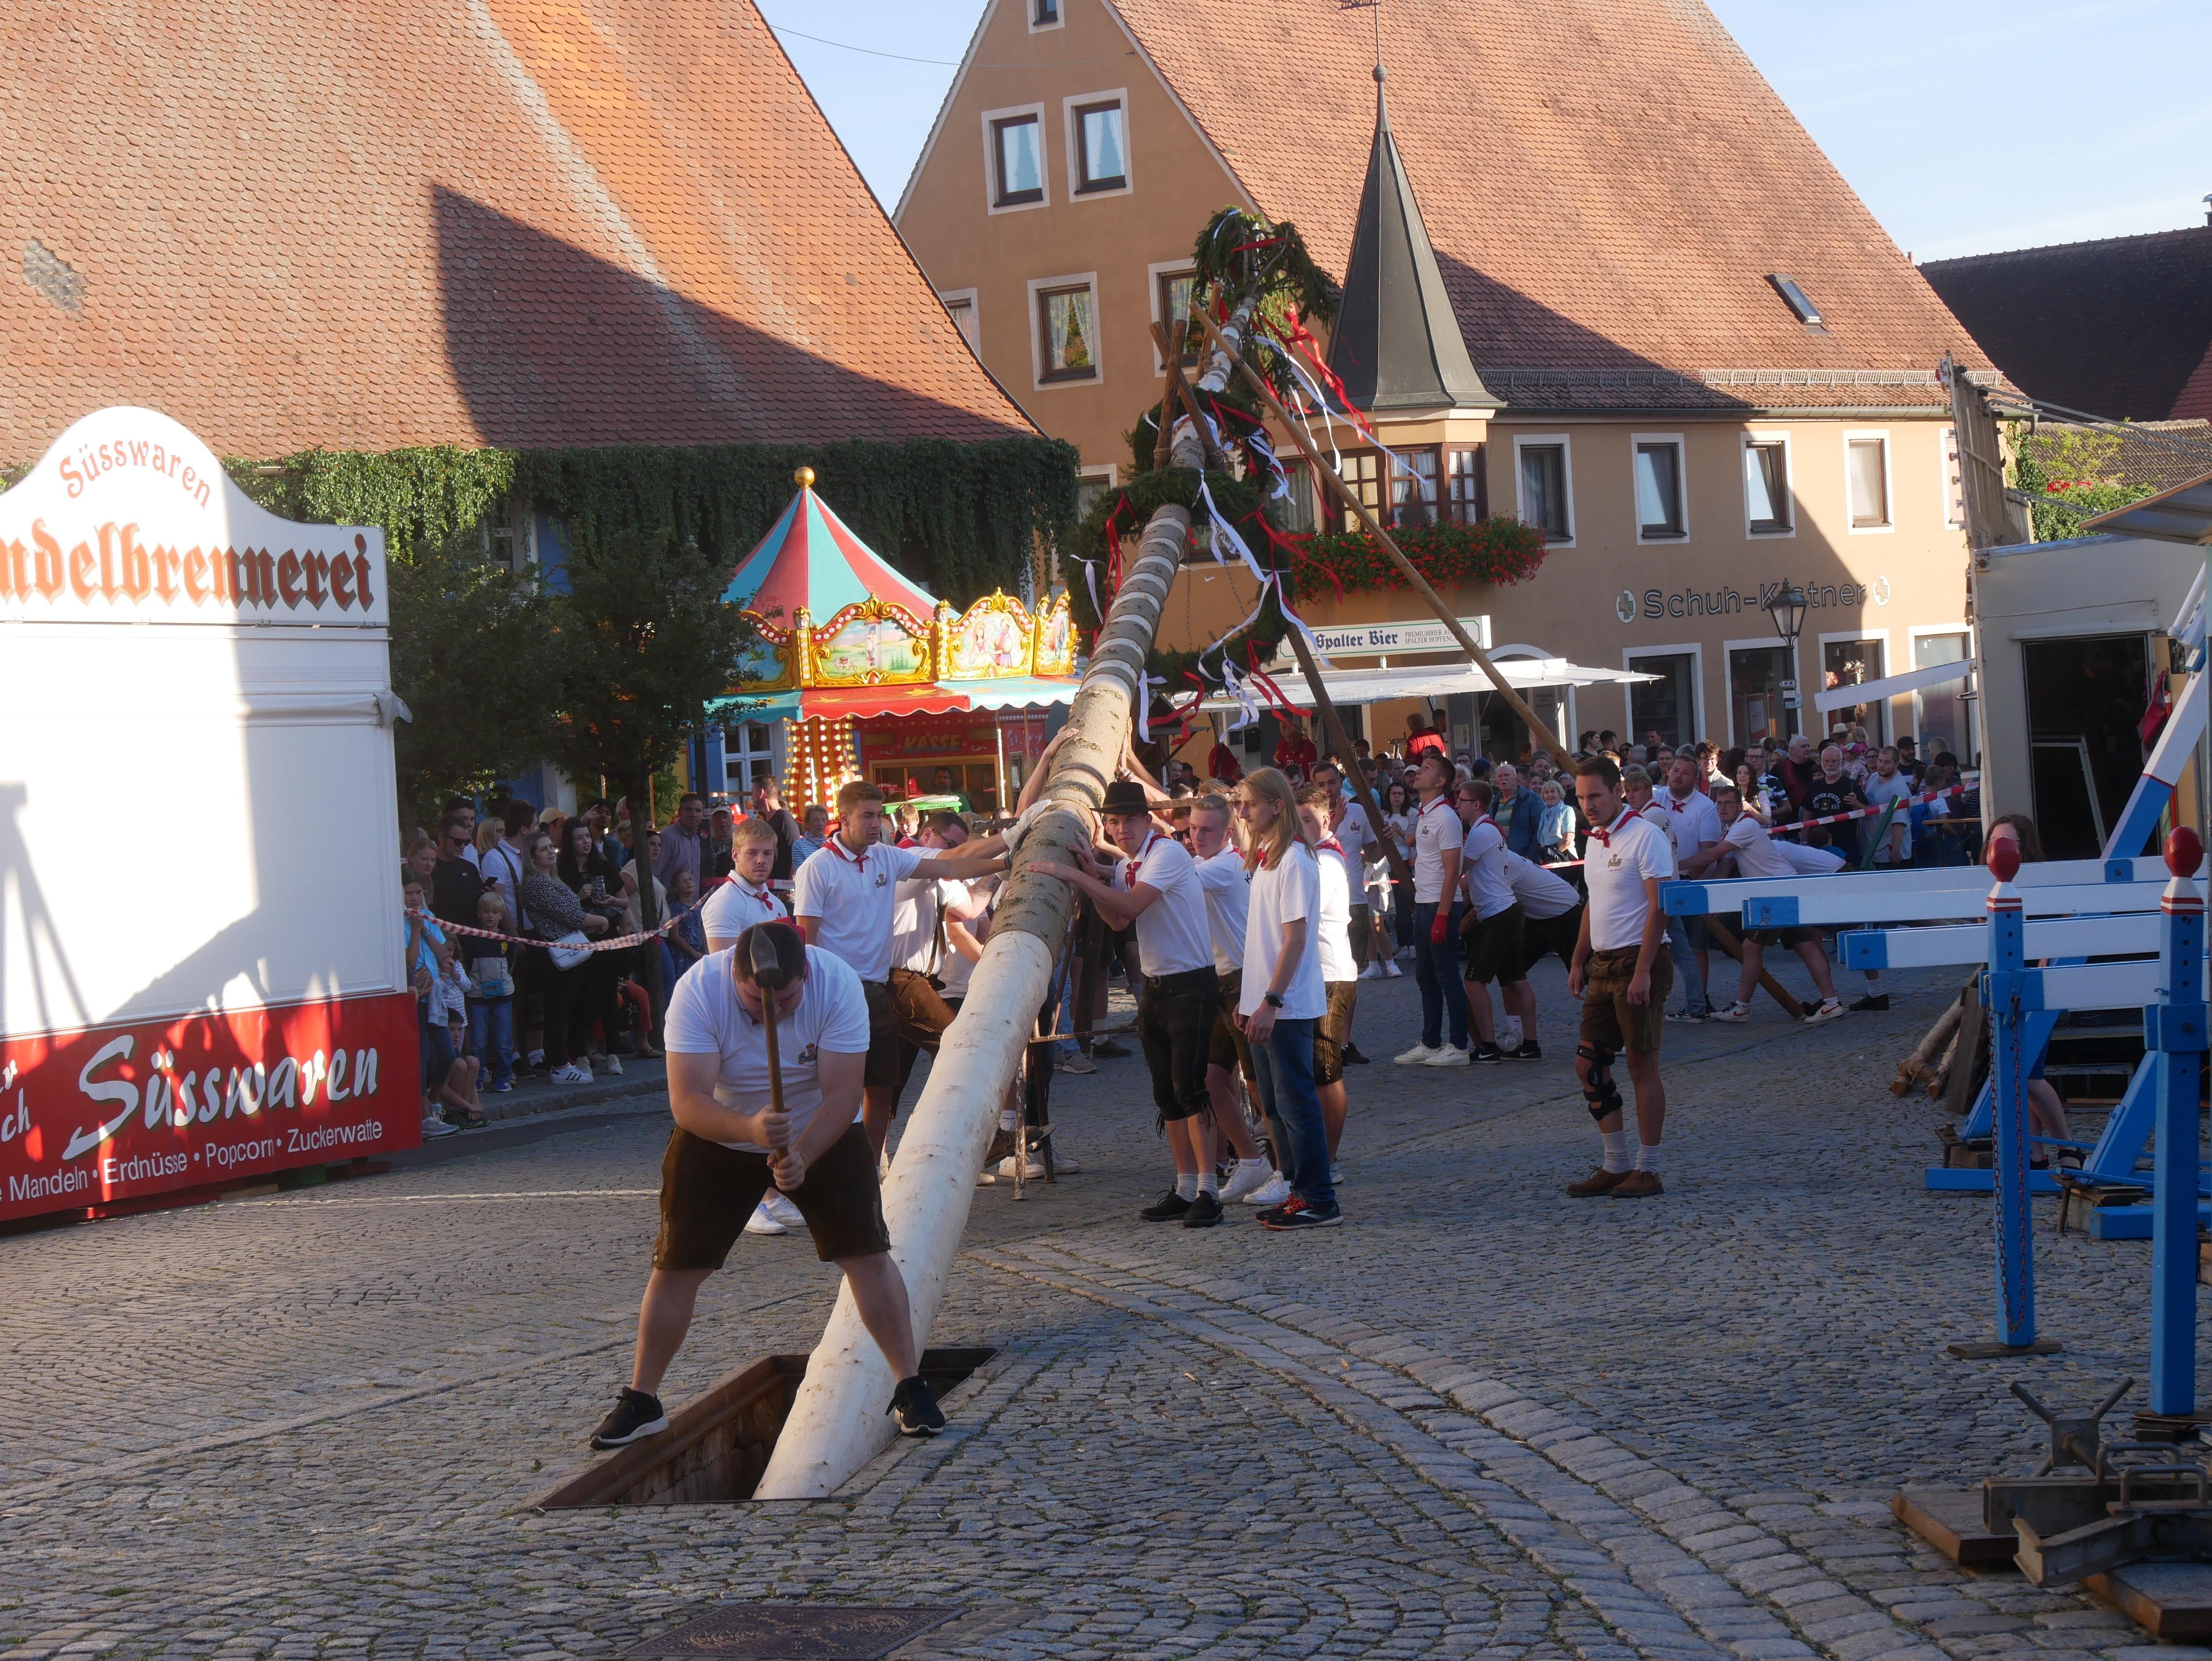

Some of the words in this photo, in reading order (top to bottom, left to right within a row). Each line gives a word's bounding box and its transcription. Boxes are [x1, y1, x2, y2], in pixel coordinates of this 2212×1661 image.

[59, 439, 211, 509] Süsswaren
[1316, 633, 1363, 651] Spalter
[1369, 629, 1398, 646] Bier
[1405, 630, 1443, 638] PREMIUMBIER
[903, 734, 961, 754] KASSE
[1812, 793, 1827, 804] UNITED
[1827, 793, 1841, 804] STATES
[62, 1034, 378, 1160] Süsswaren
[9, 1165, 88, 1201] Mandeln
[104, 1152, 187, 1184] Erdnüsse
[206, 1137, 274, 1170] Popcorn
[288, 1121, 382, 1153] Zuckerwatte
